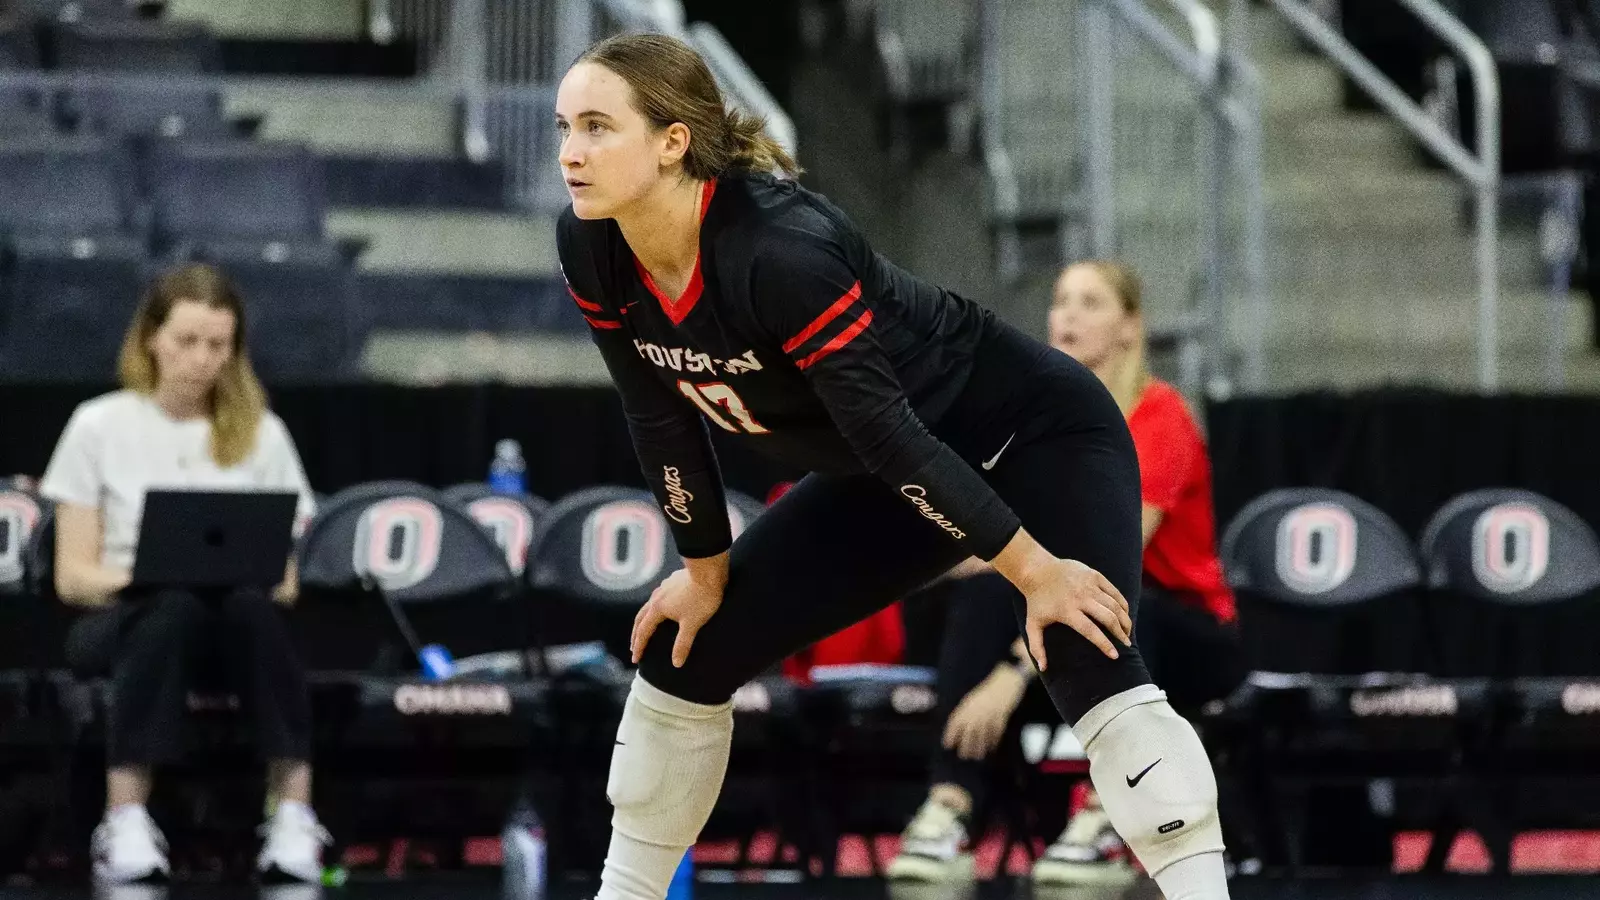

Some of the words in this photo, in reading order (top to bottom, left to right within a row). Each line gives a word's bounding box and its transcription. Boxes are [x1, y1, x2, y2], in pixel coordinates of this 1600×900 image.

[677, 379, 772, 434] 17
[663, 465, 694, 523] Cougars
[900, 484, 967, 540] Cougars
